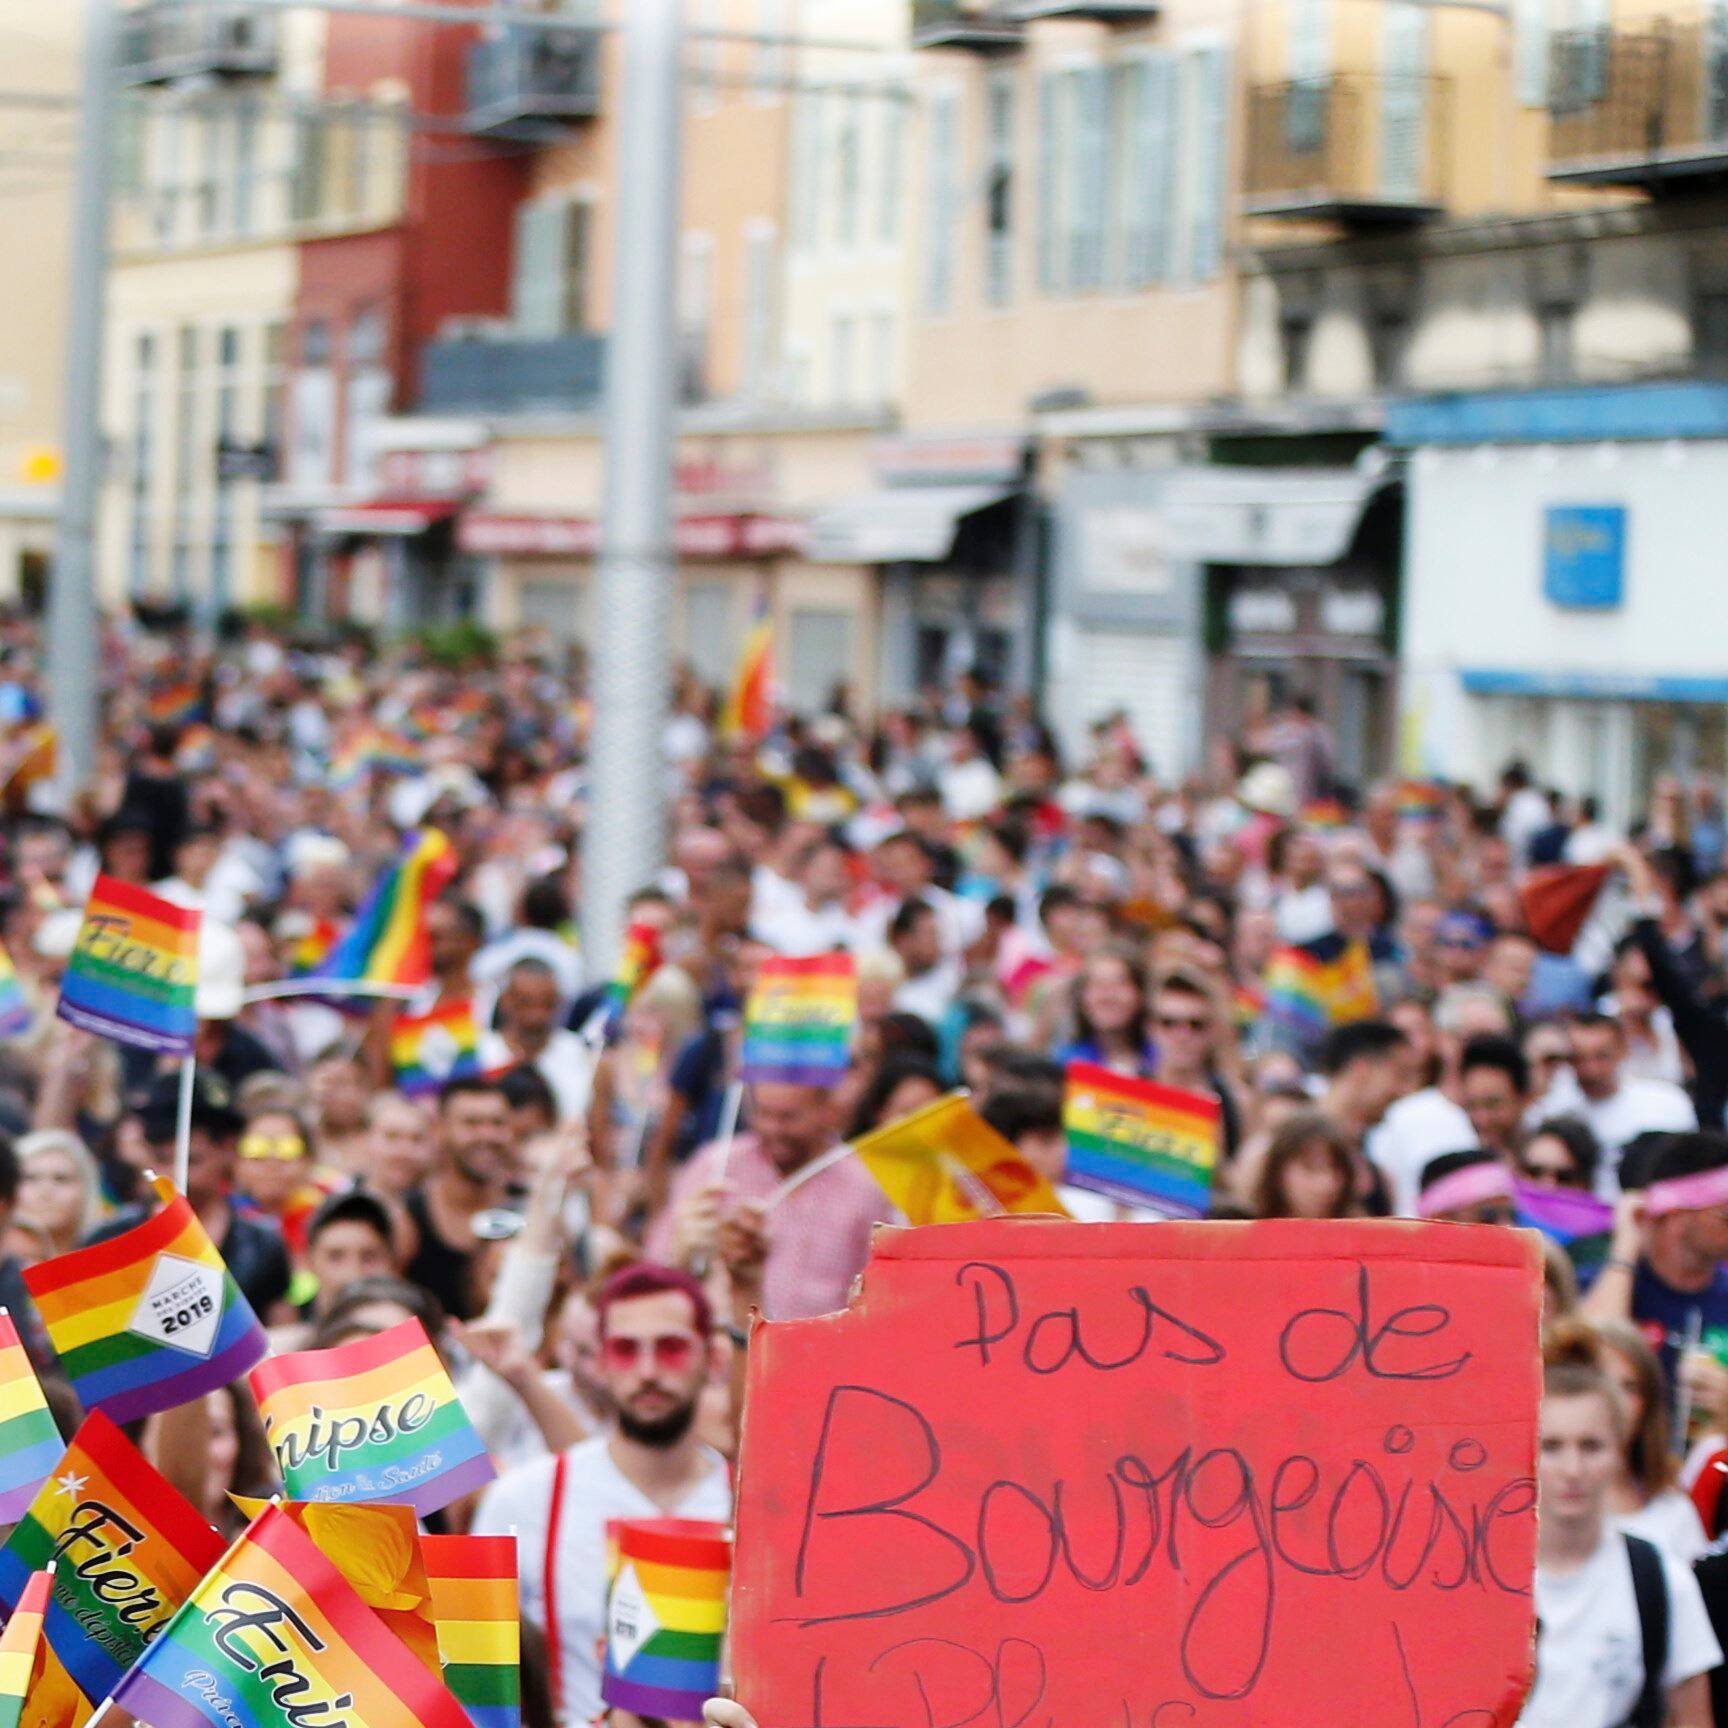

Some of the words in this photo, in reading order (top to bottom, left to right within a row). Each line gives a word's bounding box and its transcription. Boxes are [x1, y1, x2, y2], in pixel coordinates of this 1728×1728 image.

[161, 1295, 213, 1334] 2019
[955, 1262, 1225, 1373] Pas
[1279, 1259, 1472, 1382] de
